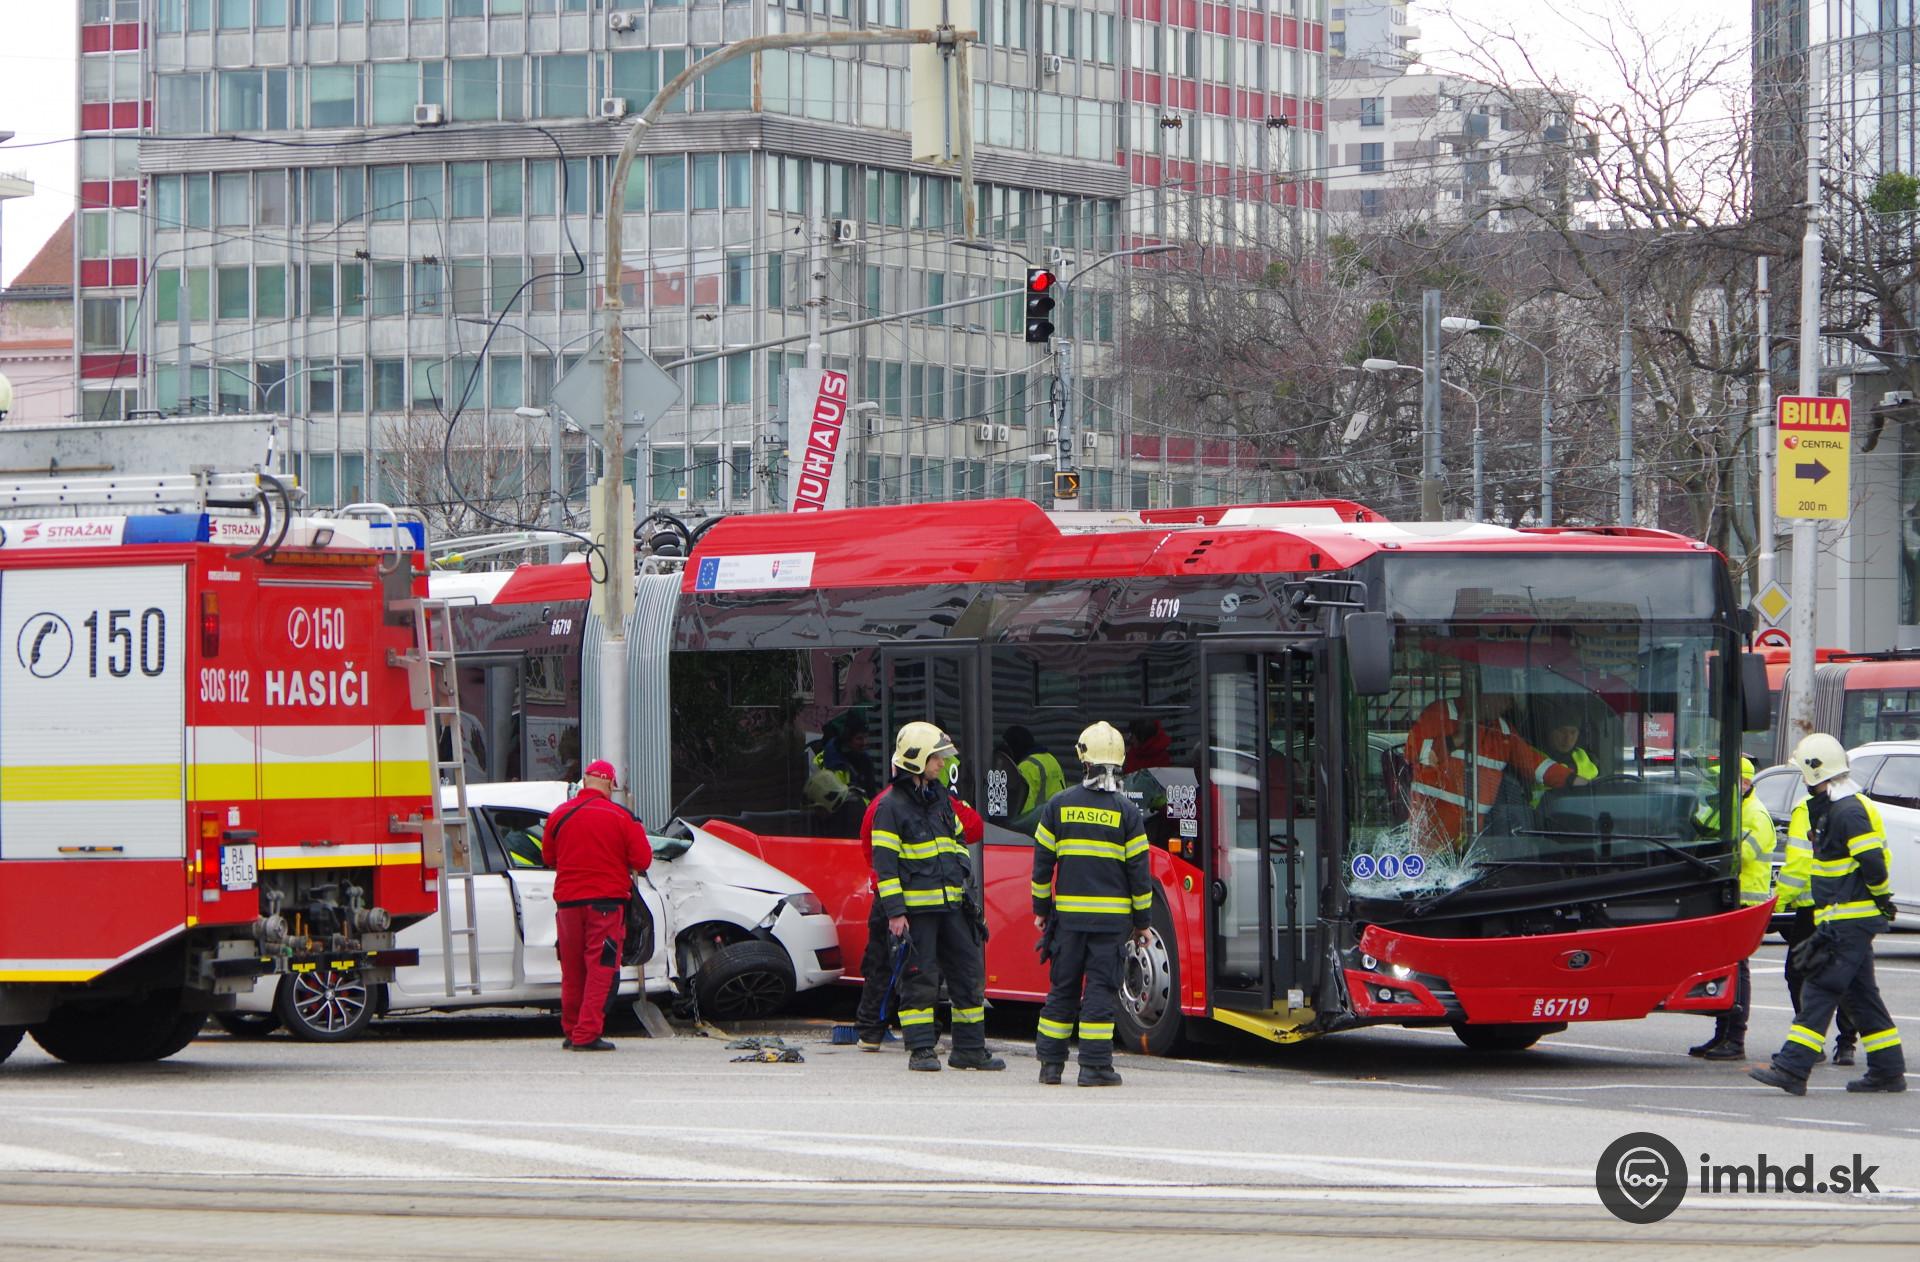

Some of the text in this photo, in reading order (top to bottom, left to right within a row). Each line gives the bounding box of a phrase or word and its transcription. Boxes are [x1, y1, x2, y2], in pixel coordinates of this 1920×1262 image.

[1782, 401, 1847, 426] BILLA
[1801, 440, 1843, 449] CENTRAL
[1798, 501, 1827, 511] 200 m
[47, 524, 113, 538] STRAŽAN
[221, 523, 261, 536] STRAŽAN
[1155, 598, 1180, 618] 6719
[312, 607, 345, 650] 150
[555, 619, 572, 635] 6719
[84, 607, 165, 678] 150
[201, 667, 249, 703] SOS 112
[265, 661, 369, 707] HASIČI
[1066, 810, 1113, 825] HASIČI
[232, 848, 244, 864] BA
[223, 864, 254, 882] 915LB
[1532, 997, 1590, 1017] DPB 6719
